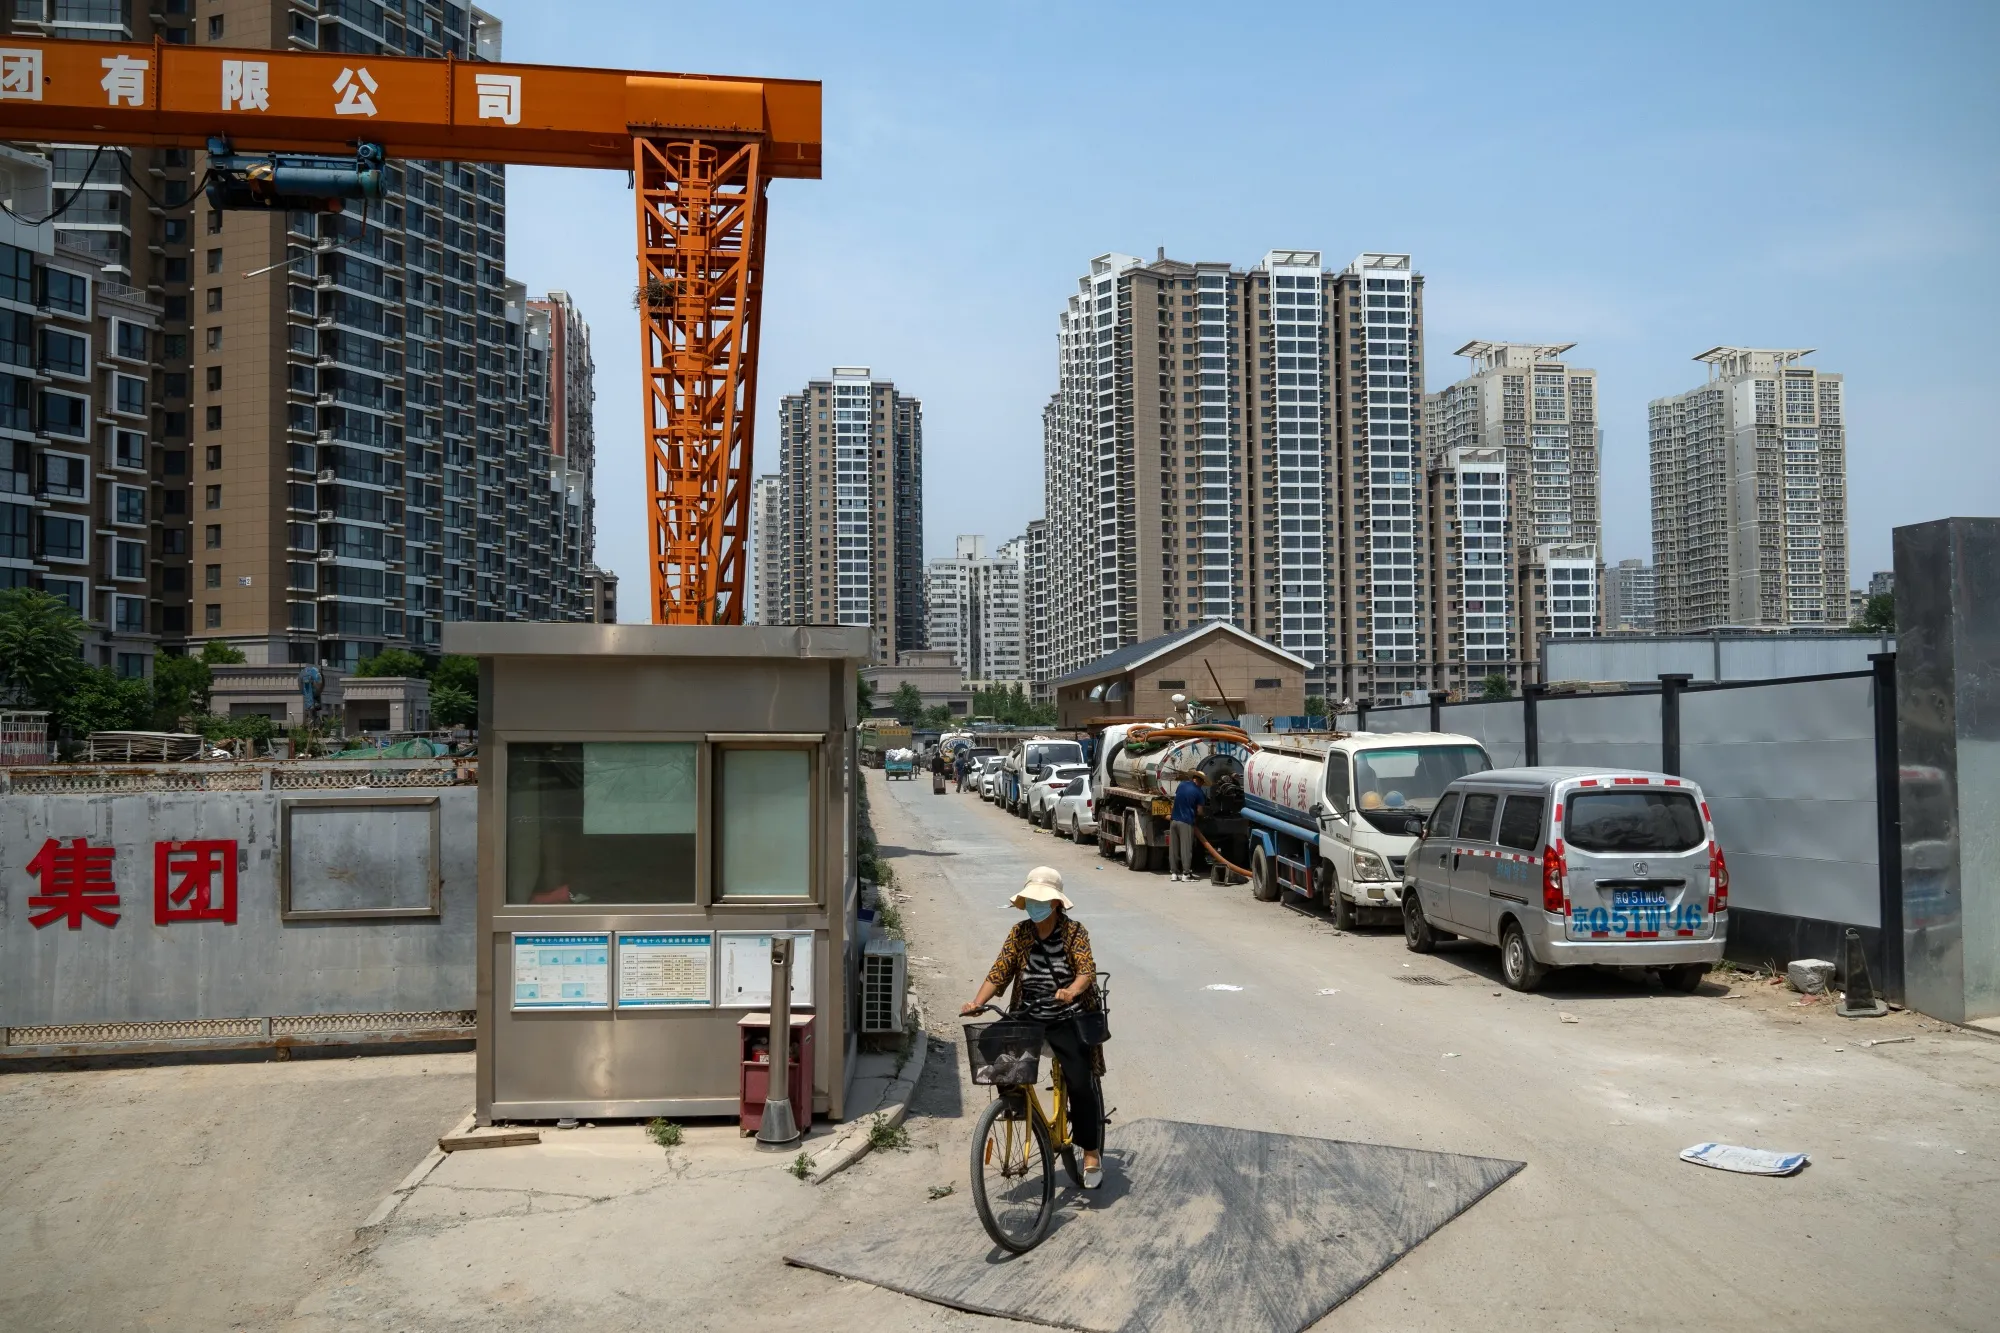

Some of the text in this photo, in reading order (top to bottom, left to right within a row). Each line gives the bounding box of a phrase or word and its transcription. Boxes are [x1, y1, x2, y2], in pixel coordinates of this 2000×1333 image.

[0, 47, 522, 126] 团有限公司
[26, 838, 239, 930] 集团
[1571, 904, 1703, 934] 京Q51WU6
